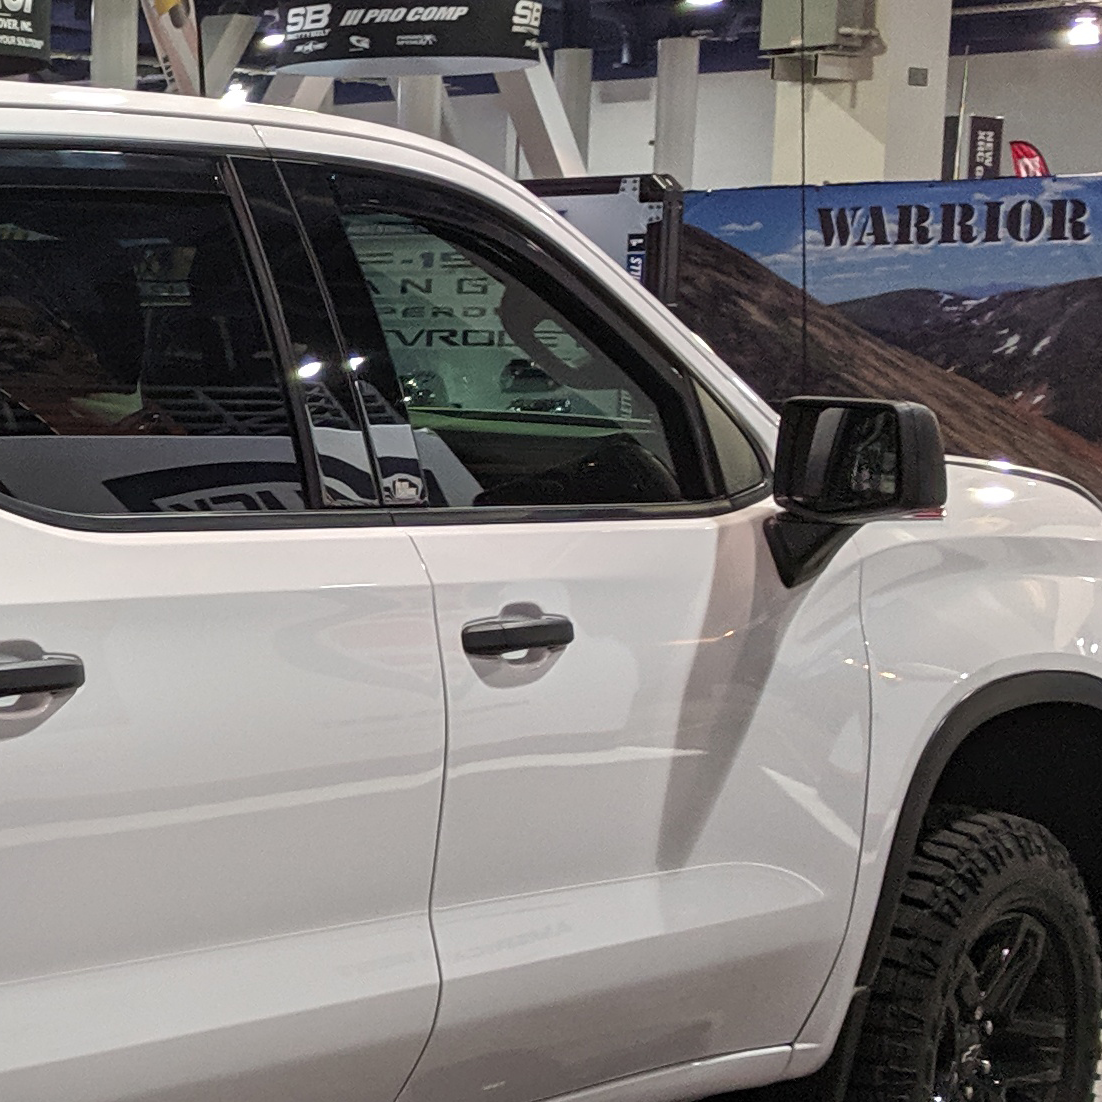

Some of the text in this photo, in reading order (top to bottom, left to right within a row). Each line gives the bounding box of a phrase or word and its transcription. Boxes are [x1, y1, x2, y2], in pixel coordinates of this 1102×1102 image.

[362, 6, 469, 24] PRO COMP
[817, 200, 1091, 248] WARRIOR
